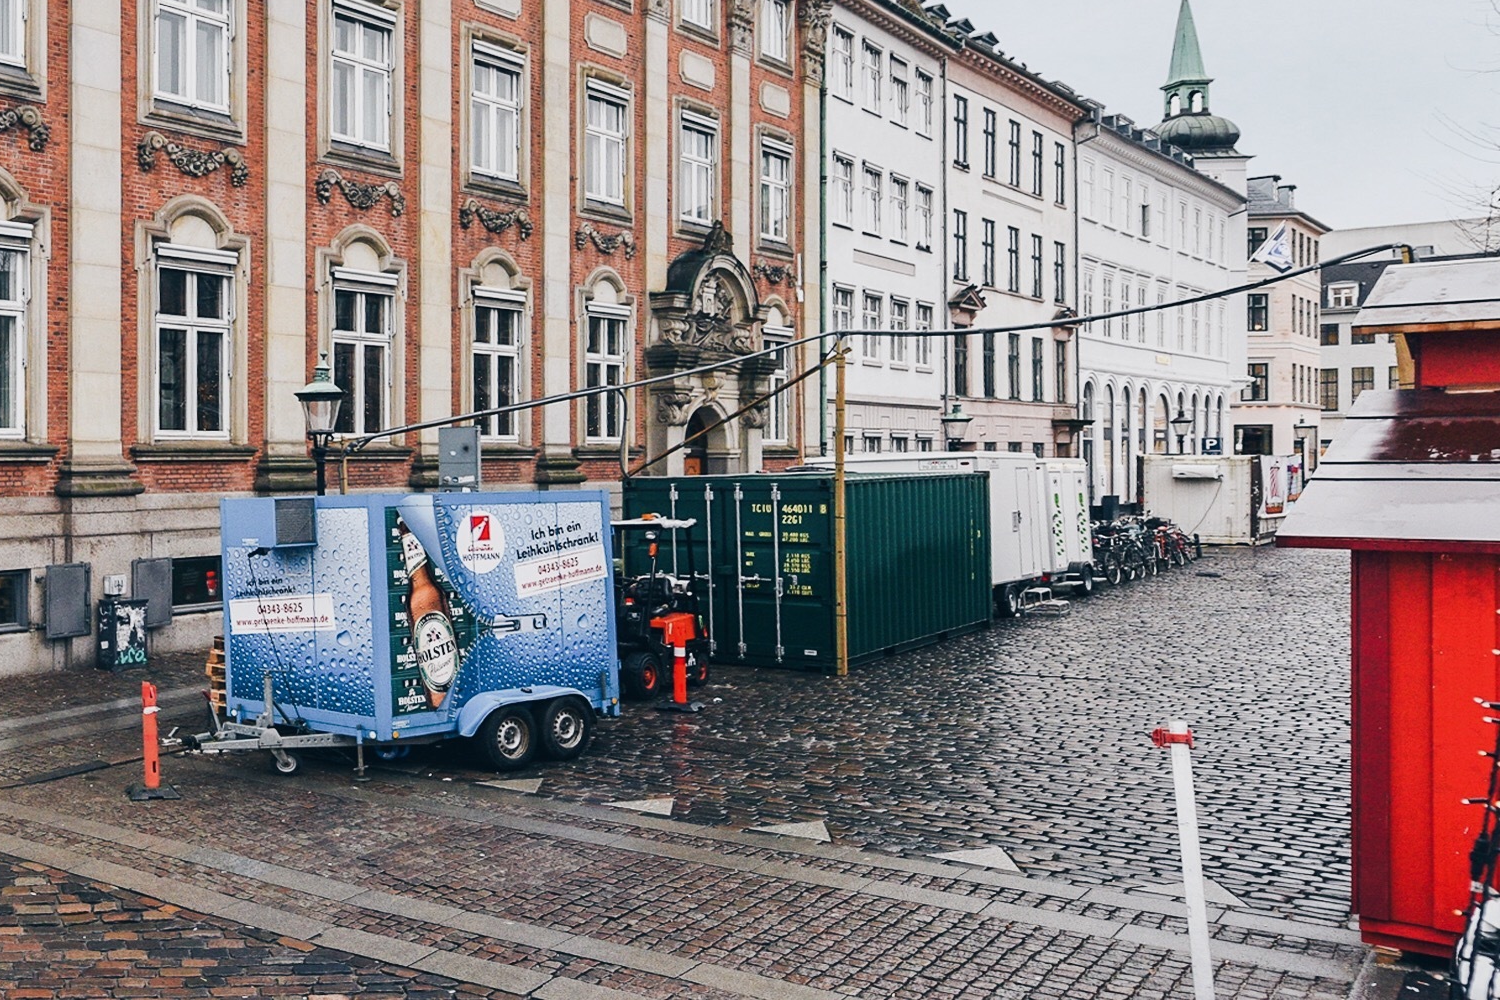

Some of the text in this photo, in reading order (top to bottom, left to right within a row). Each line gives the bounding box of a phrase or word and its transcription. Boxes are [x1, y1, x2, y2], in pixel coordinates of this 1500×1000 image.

[1205, 439, 1218, 450] P
[751, 504, 772, 513] TCIU
[782, 504, 813, 513] 464011
[530, 521, 582, 541] Ich bin ein
[516, 532, 599, 560] Leihkühlschrank!
[462, 552, 500, 562] HOFFMANN
[538, 557, 579, 575] 04343-8625
[257, 602, 303, 614] 04343-8625
